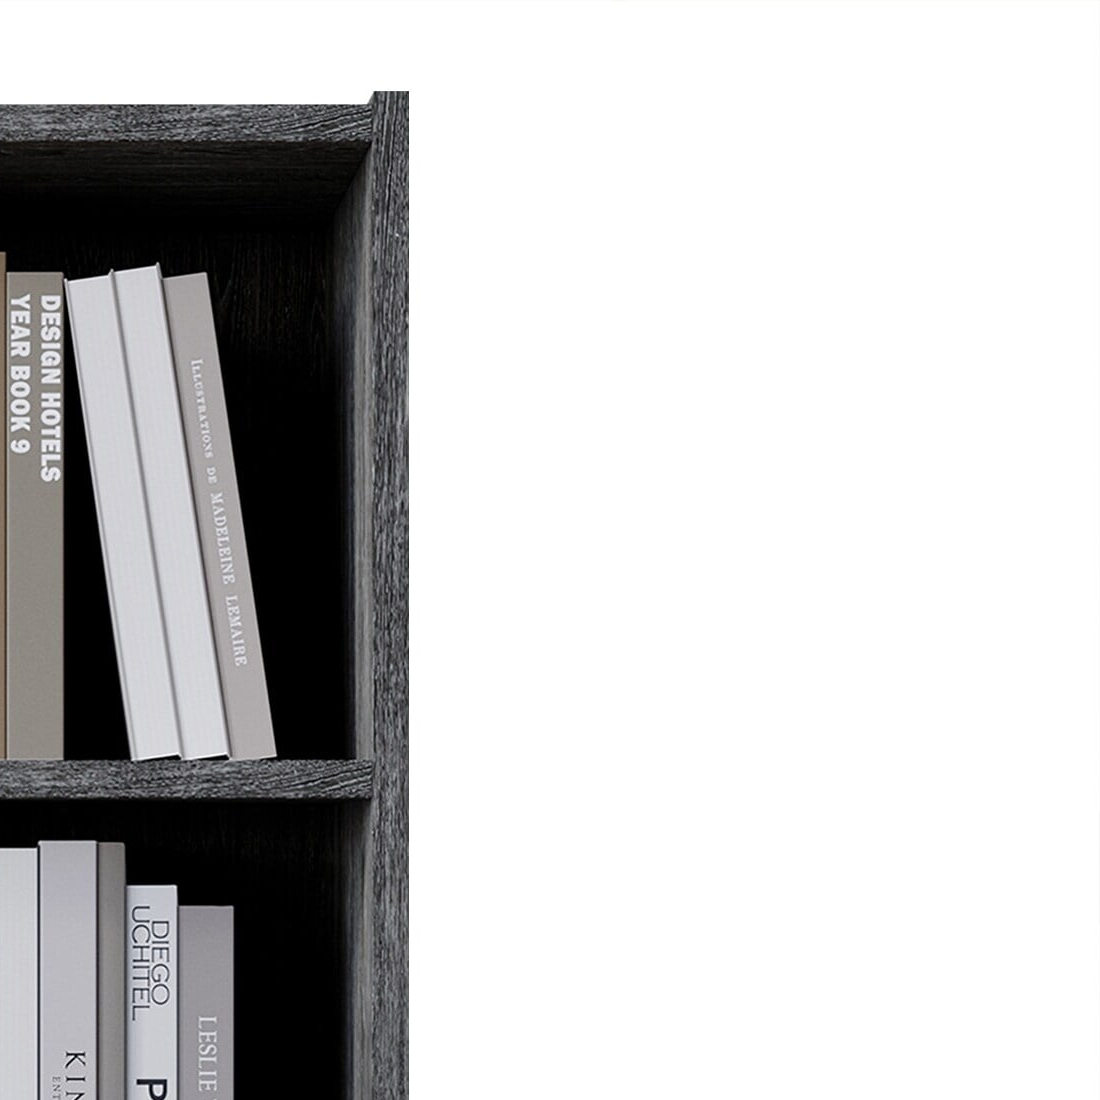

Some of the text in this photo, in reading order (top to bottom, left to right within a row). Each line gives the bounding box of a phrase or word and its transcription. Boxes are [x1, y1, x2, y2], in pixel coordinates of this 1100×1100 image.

[11, 294, 30, 453] YEAR BOOK 9
[41, 296, 61, 481] DESIGN HOTELS
[210, 492, 236, 585] MADELEINE
[226, 596, 247, 666] LEMAIRE
[132, 906, 150, 1021] UCHITEL
[150, 920, 170, 1006] DIEGO
[199, 1017, 217, 1091] LESLIE
